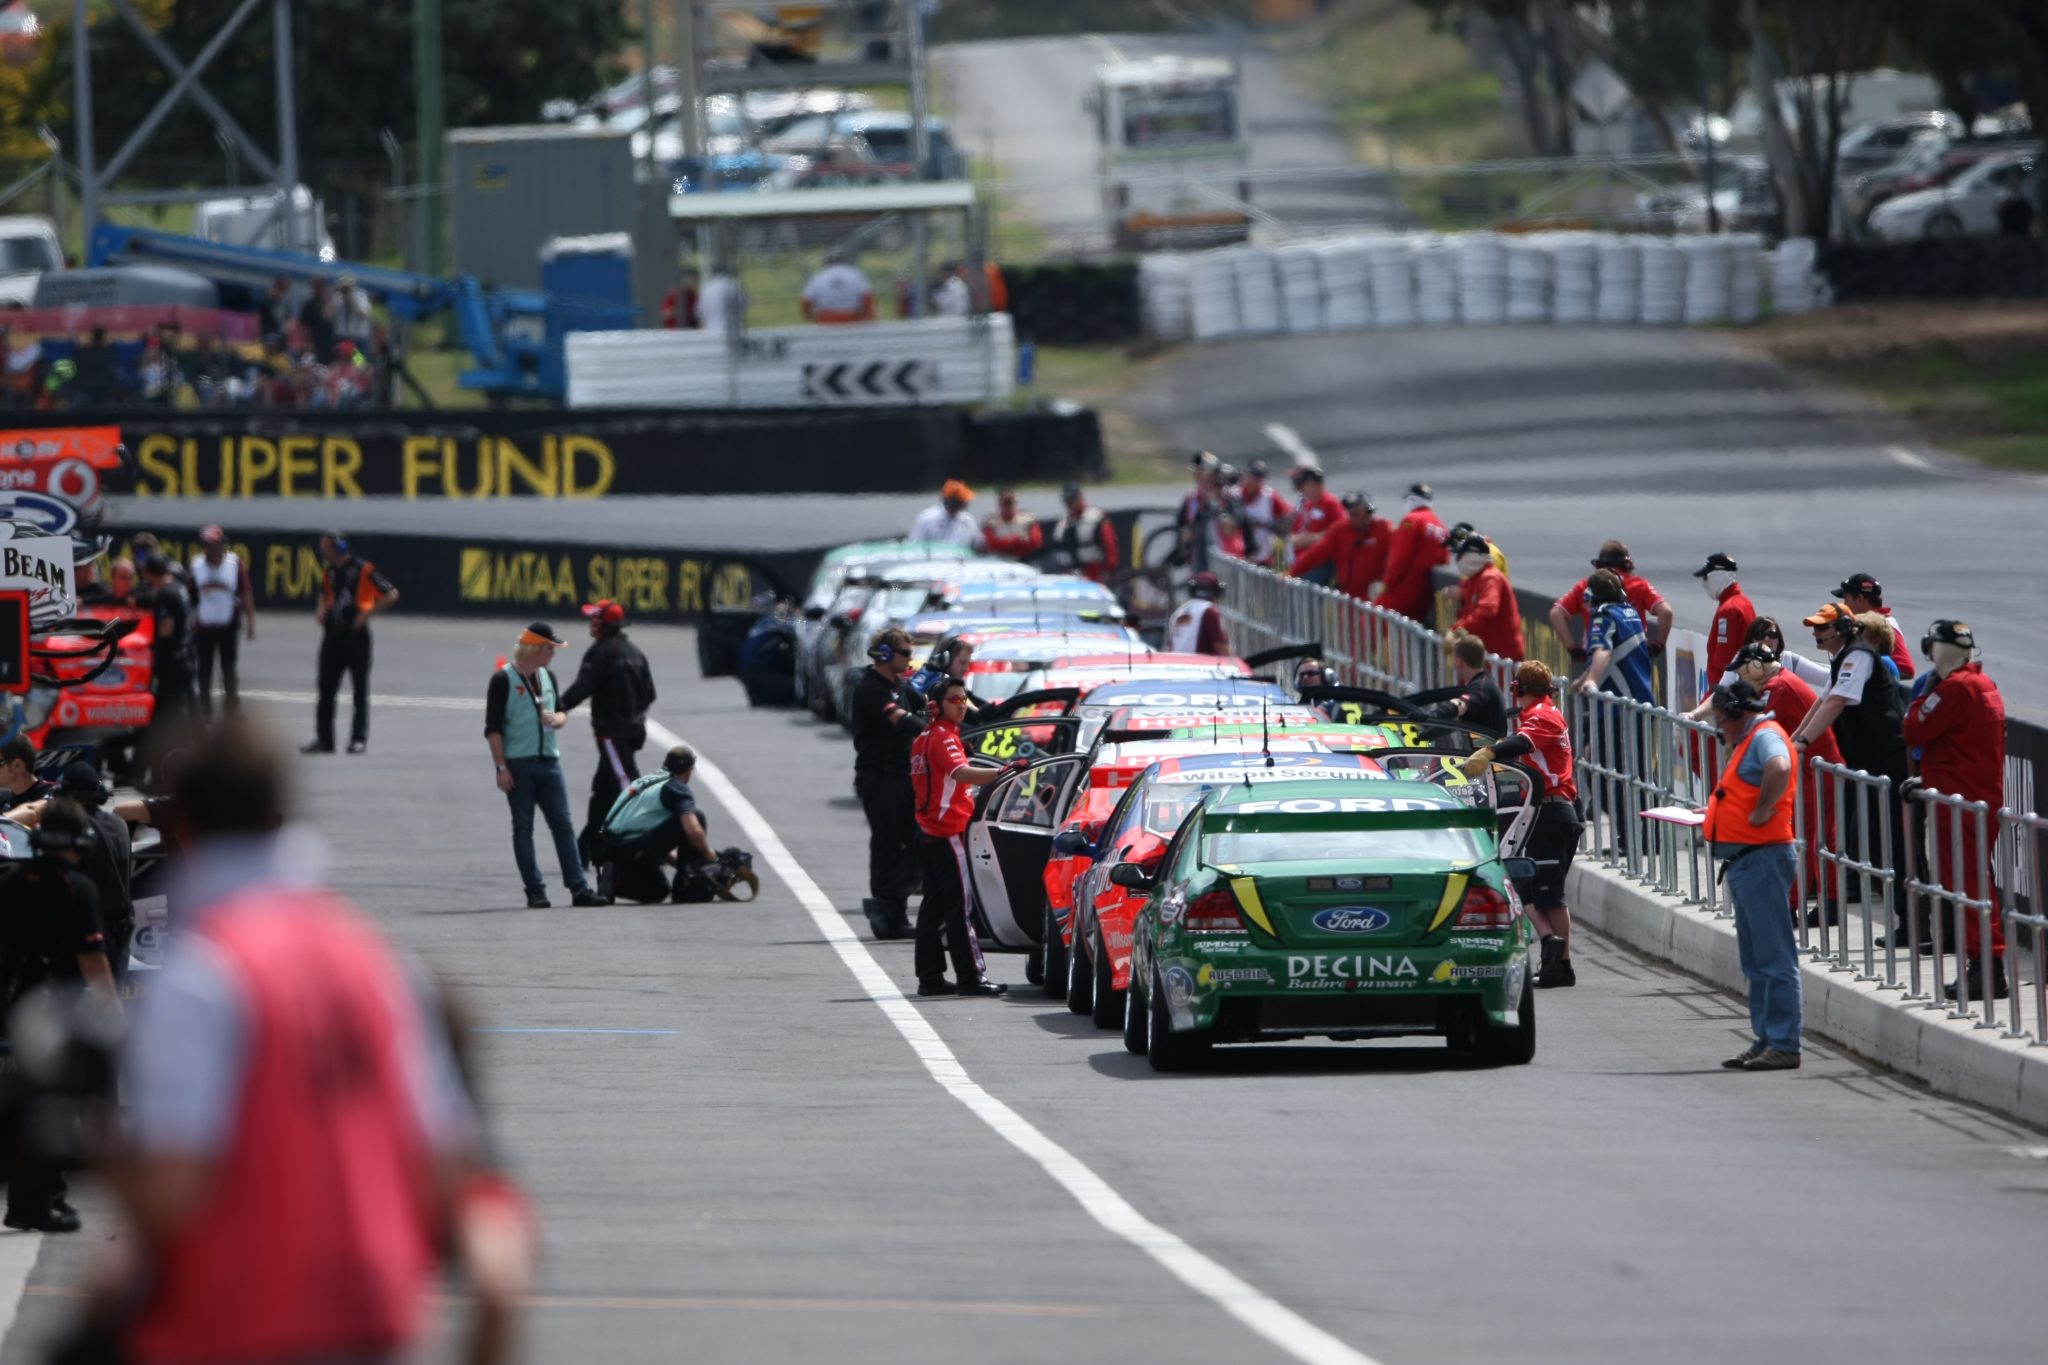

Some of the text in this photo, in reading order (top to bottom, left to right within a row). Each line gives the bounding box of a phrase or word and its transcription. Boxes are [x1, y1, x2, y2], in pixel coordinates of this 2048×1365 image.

[136, 434, 615, 498] SUPER FUND
[4, 547, 67, 587] BEAM
[265, 544, 325, 598] FUN
[494, 551, 577, 604] MTAA
[587, 553, 669, 611] SUPER
[1183, 769, 1267, 782] Wilson
[1238, 798, 1440, 814] FORD
[1327, 909, 1376, 929] Ford
[1288, 955, 1419, 977] DECINA
[1286, 978, 1417, 989] Bathromware
